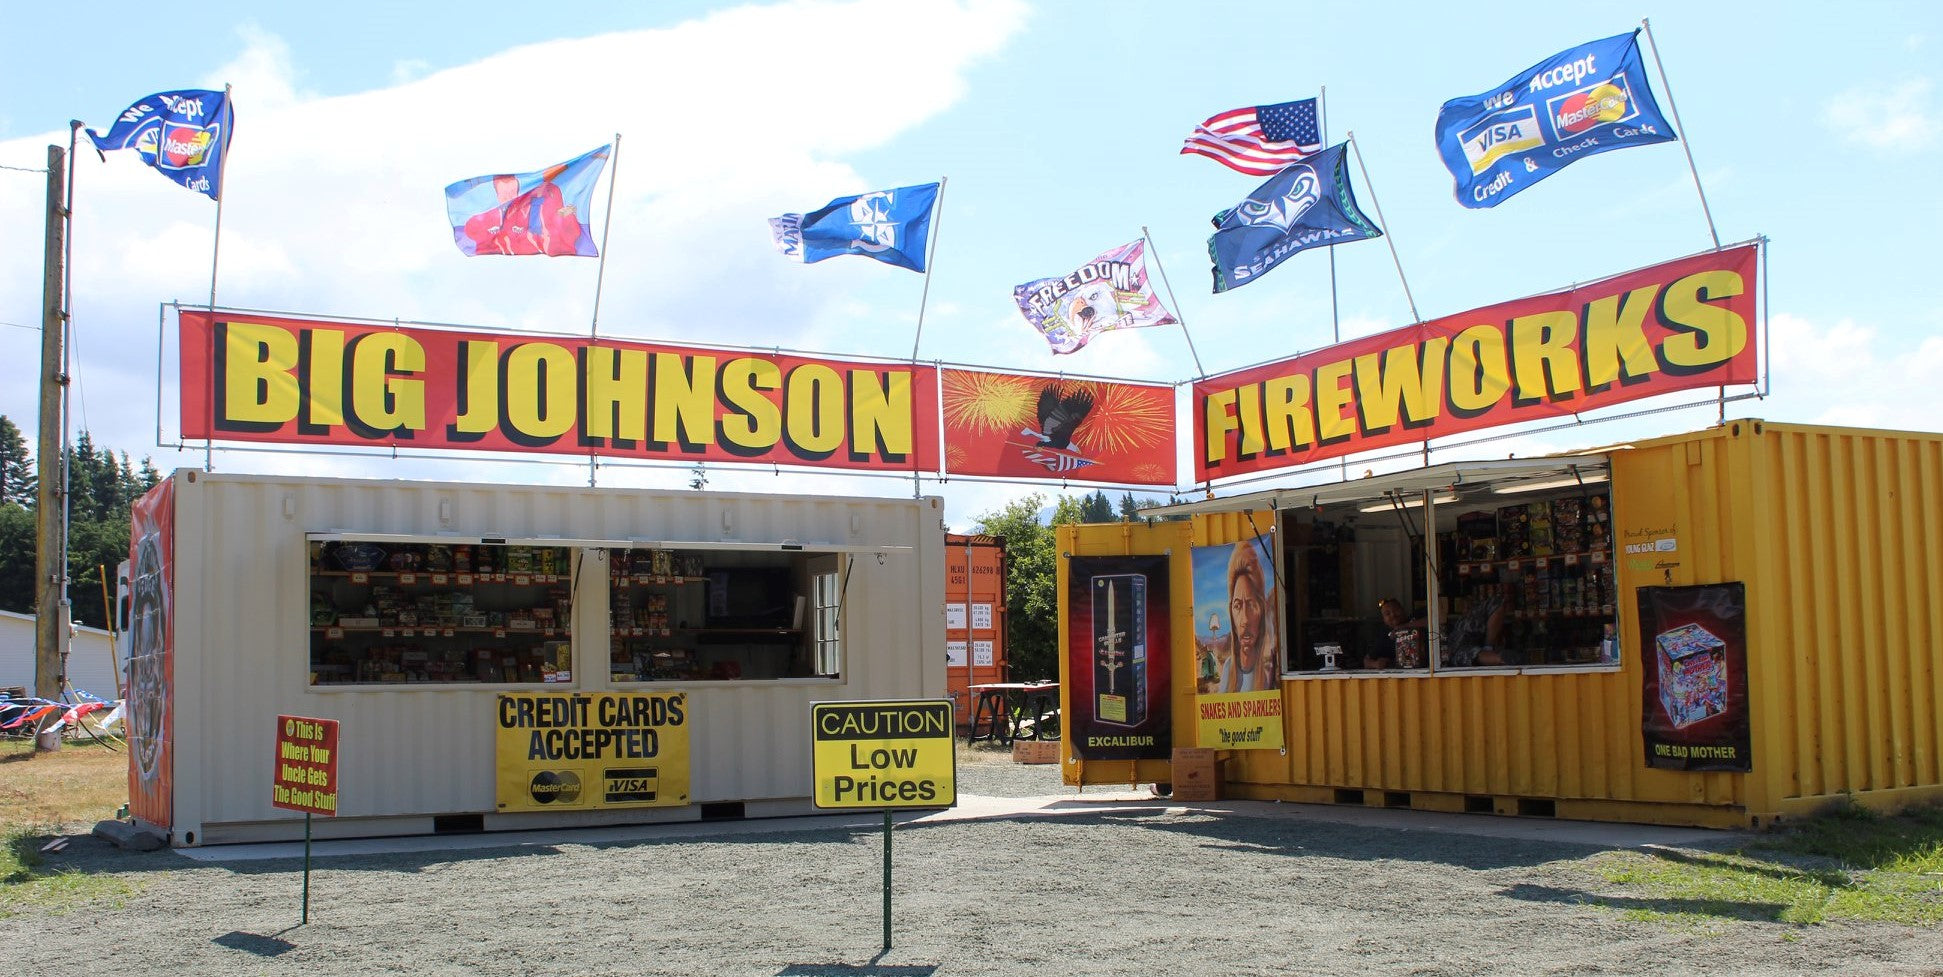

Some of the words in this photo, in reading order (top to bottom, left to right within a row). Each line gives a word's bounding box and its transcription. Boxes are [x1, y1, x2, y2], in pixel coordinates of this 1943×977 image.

[1483, 90, 1514, 110] We
[1528, 52, 1596, 93] Accept
[120, 104, 154, 123] We
[1556, 88, 1628, 130] MasterCard
[1477, 124, 1522, 152] VISA
[1474, 170, 1514, 202] Credit
[1524, 157, 1539, 173] &
[1552, 136, 1598, 158] Check
[1613, 124, 1656, 140] Cards
[186, 176, 210, 192] Cards
[1234, 228, 1354, 280] SEAHAWKS
[1029, 261, 1131, 319] FREEDOM
[1204, 270, 1747, 468] FIREWORKS
[217, 322, 427, 438] BIG
[450, 339, 913, 461] JOHNSON
[500, 696, 592, 728] CREDIT
[600, 696, 684, 727] CARDS
[822, 710, 944, 734] CAUTION
[1200, 702, 1226, 720] SNAKES
[1228, 702, 1242, 718] AND
[1243, 699, 1280, 718] SPARKLERS
[296, 720, 314, 740] This
[315, 723, 324, 740] Is
[1088, 736, 1154, 747] EXCALIBUR
[1232, 728, 1246, 746] good
[282, 741, 308, 761] Where
[310, 744, 330, 764] Your
[528, 728, 659, 760] ACCEPTED
[1656, 744, 1672, 757] ONE
[1672, 744, 1688, 758] BAD
[1690, 746, 1736, 758] MOTHER
[851, 744, 918, 770] Low
[282, 764, 306, 783] Uncle
[308, 767, 328, 786] Gets
[531, 782, 581, 793] MasterCard
[610, 780, 648, 792] VISA
[274, 785, 290, 804] The
[291, 787, 314, 808] Good
[314, 790, 336, 810] Stuff
[834, 775, 936, 802] Prices
